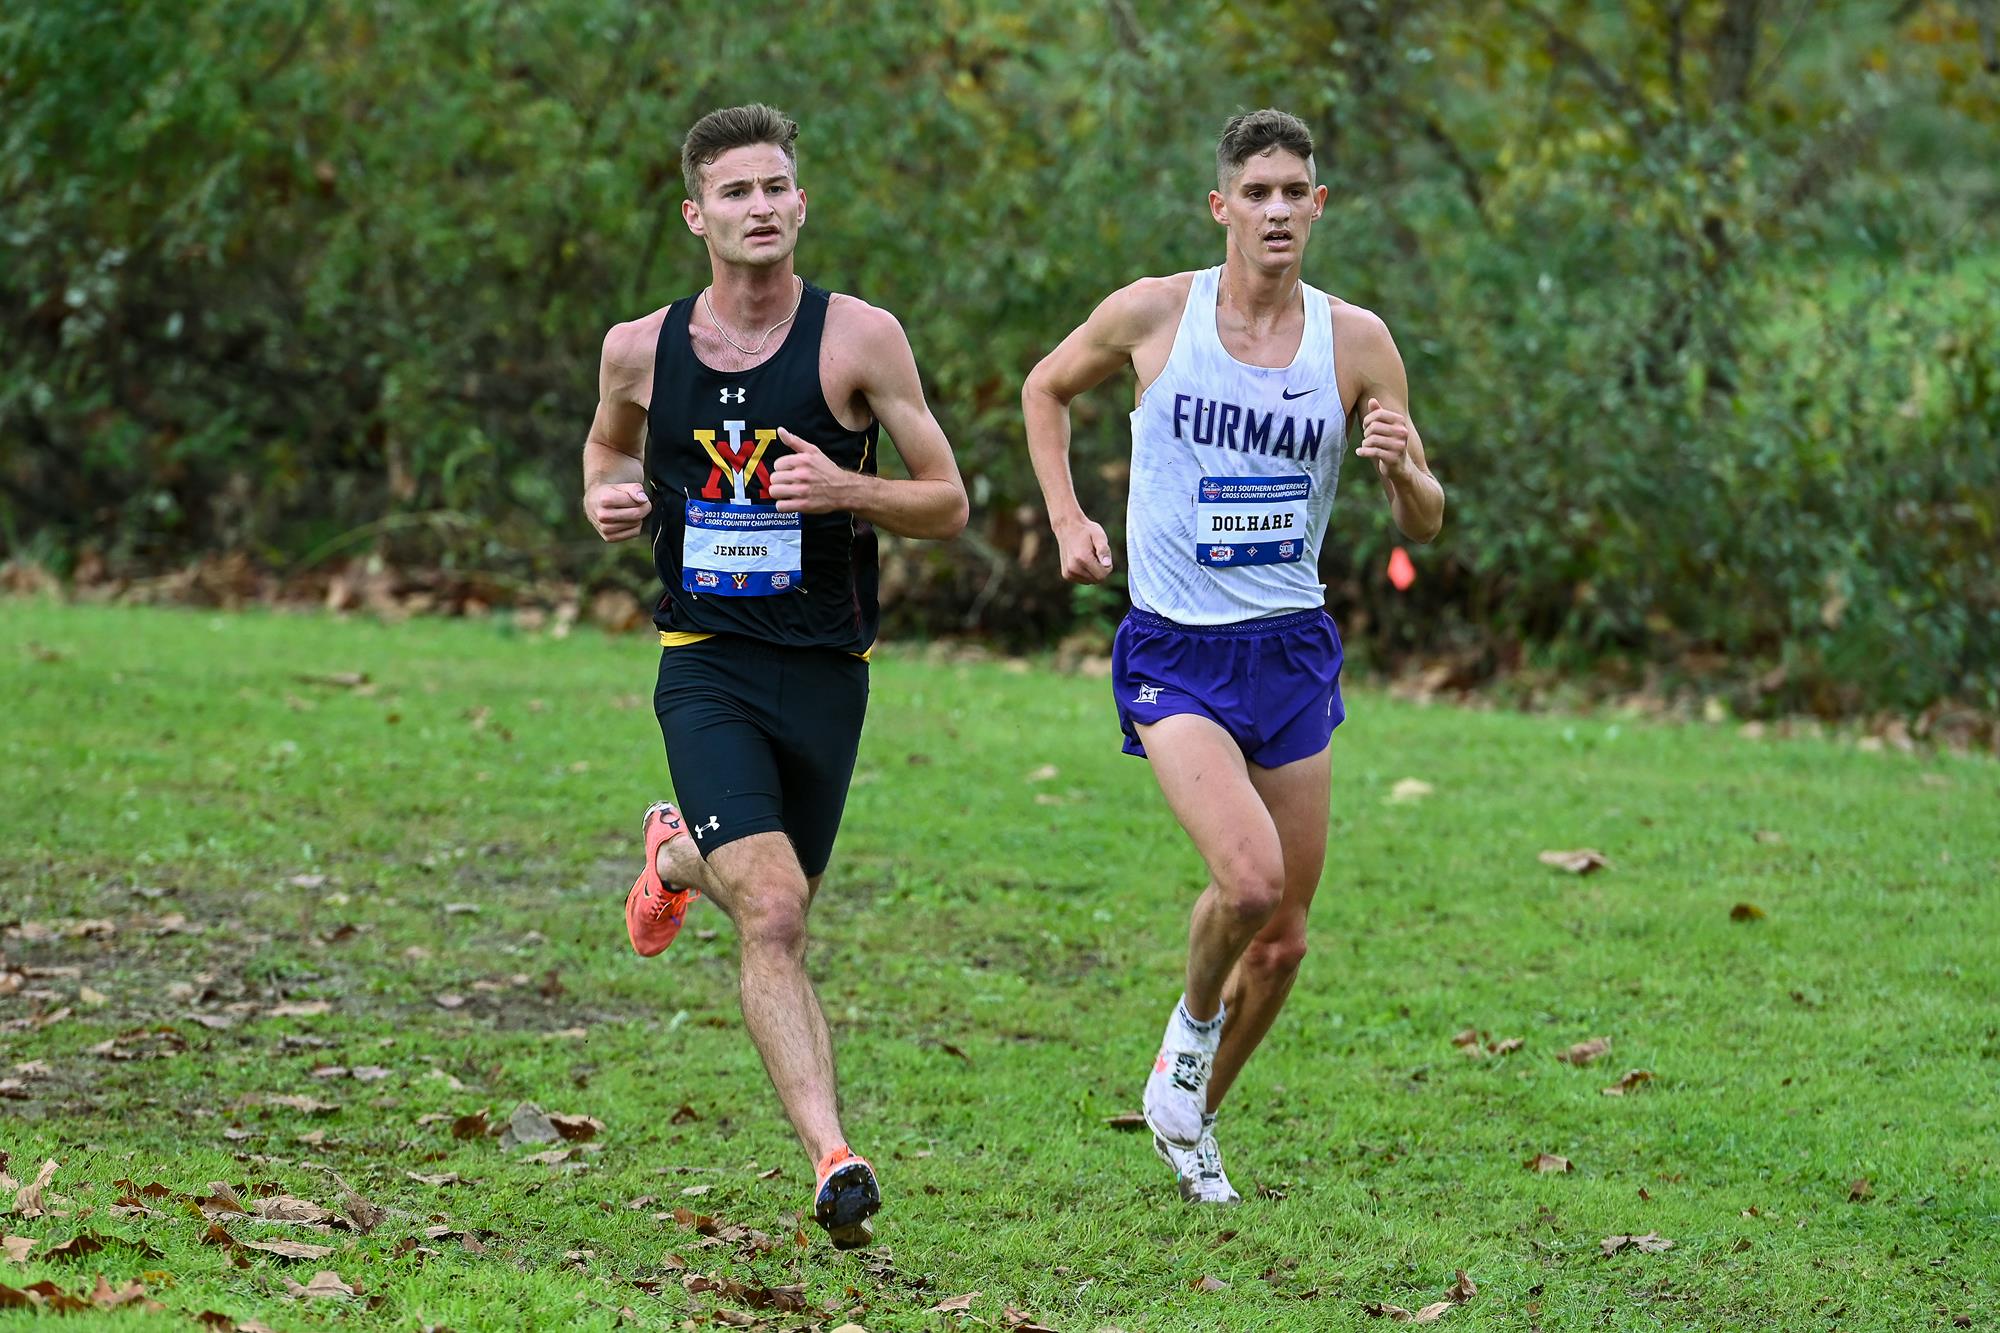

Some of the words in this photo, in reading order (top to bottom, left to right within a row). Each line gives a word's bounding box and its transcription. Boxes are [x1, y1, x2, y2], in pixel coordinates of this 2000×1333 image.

[1173, 393, 1326, 462] FURMAN
[1272, 483, 1308, 491] CONFERENCE
[1267, 490, 1306, 499] CHAMPIONSHIPS
[721, 511, 755, 520] SOUTHERN
[704, 518, 722, 526] CROSS
[723, 519, 750, 527] COUNTRY
[1211, 513, 1294, 532] DOLHARE
[713, 545, 768, 557] JENKINS
